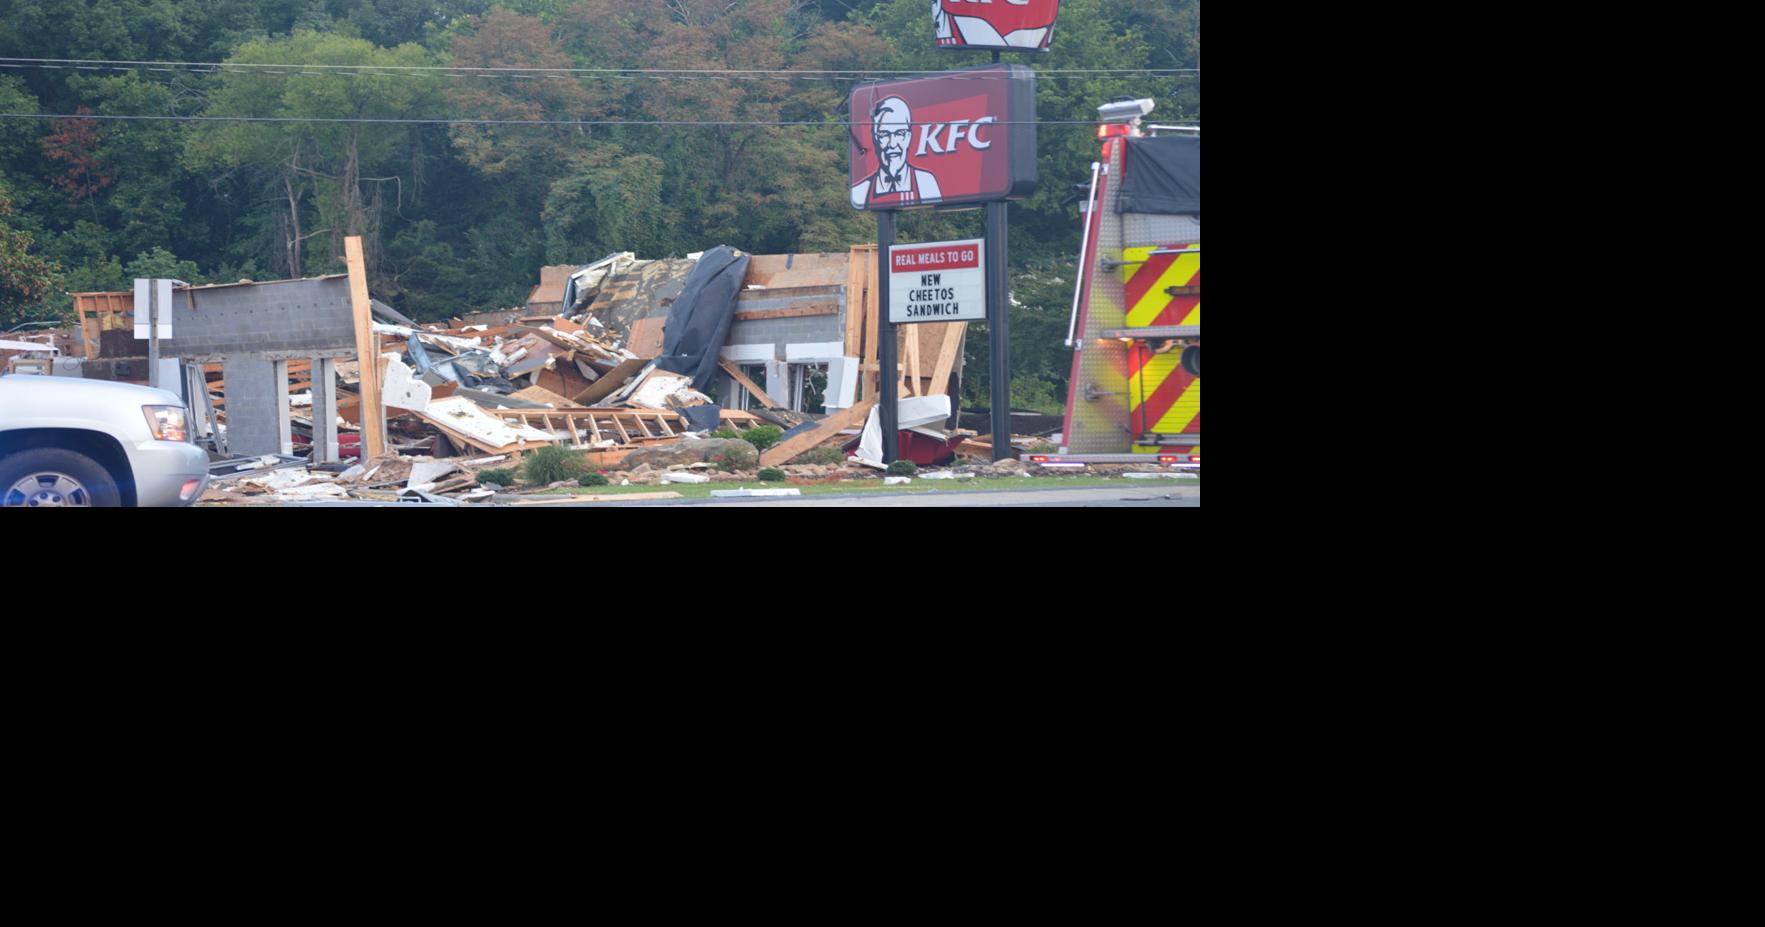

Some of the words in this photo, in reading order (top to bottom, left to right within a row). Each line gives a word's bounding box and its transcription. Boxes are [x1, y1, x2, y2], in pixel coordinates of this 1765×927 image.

[914, 116, 993, 156] KFC
[895, 254, 916, 266] REAL
[918, 252, 945, 264] MEALS
[947, 251, 959, 263] TO
[961, 250, 974, 262] GO
[921, 273, 941, 286] NEW
[909, 287, 954, 302] CHEETOS
[906, 302, 959, 317] SANDWICH
